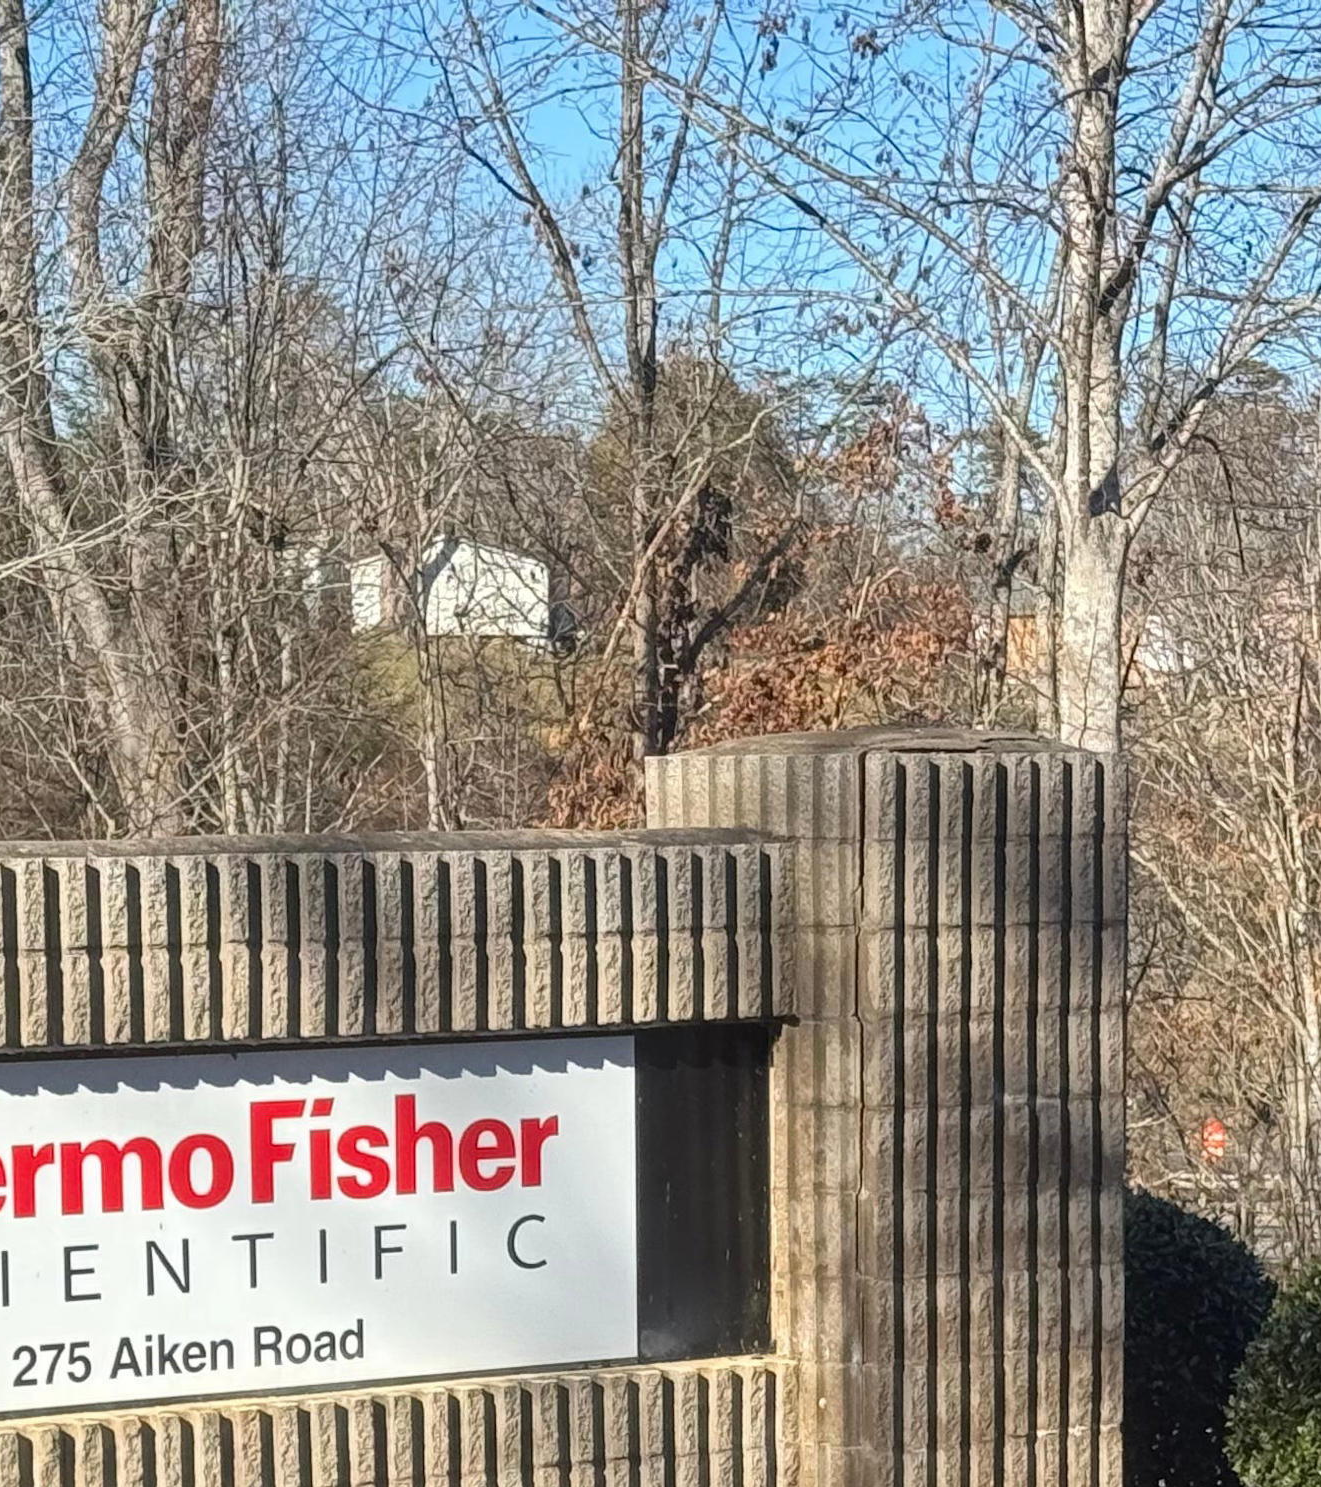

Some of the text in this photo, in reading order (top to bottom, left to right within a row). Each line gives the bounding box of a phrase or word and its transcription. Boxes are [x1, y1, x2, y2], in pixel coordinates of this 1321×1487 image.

[13, 1318, 364, 1387] 275 Aiken Road
